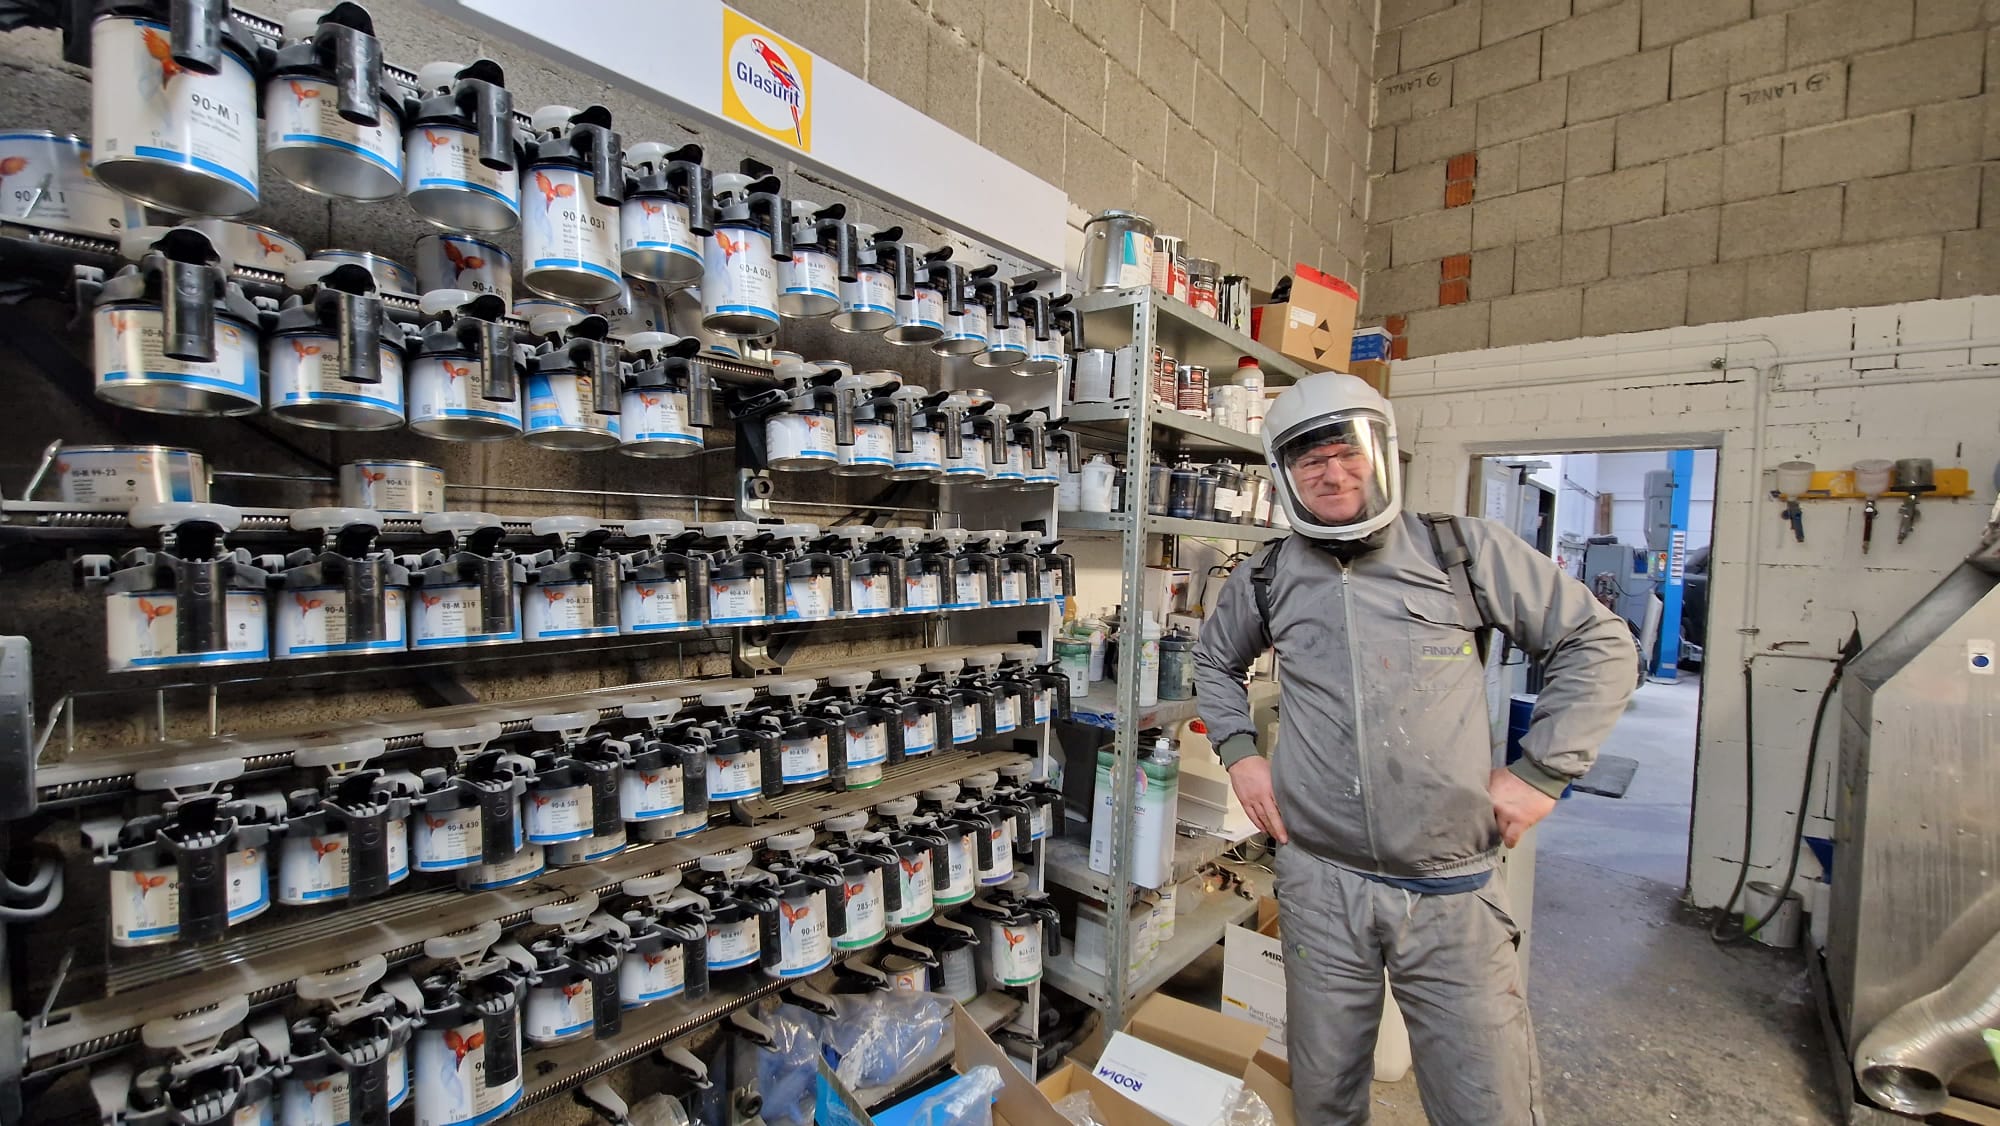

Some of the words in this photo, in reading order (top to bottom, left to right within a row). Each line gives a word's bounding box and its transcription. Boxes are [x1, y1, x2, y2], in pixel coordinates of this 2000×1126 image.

[736, 61, 801, 108] Glasurit
[191, 93, 230, 121] 90-M
[235, 112, 240, 126] 1
[15, 190, 53, 203] 90M
[562, 210, 587, 224] 90A
[589, 217, 606, 231] 031
[472, 280, 493, 293] 90-A
[1099, 1066, 1143, 1092] RODIM
